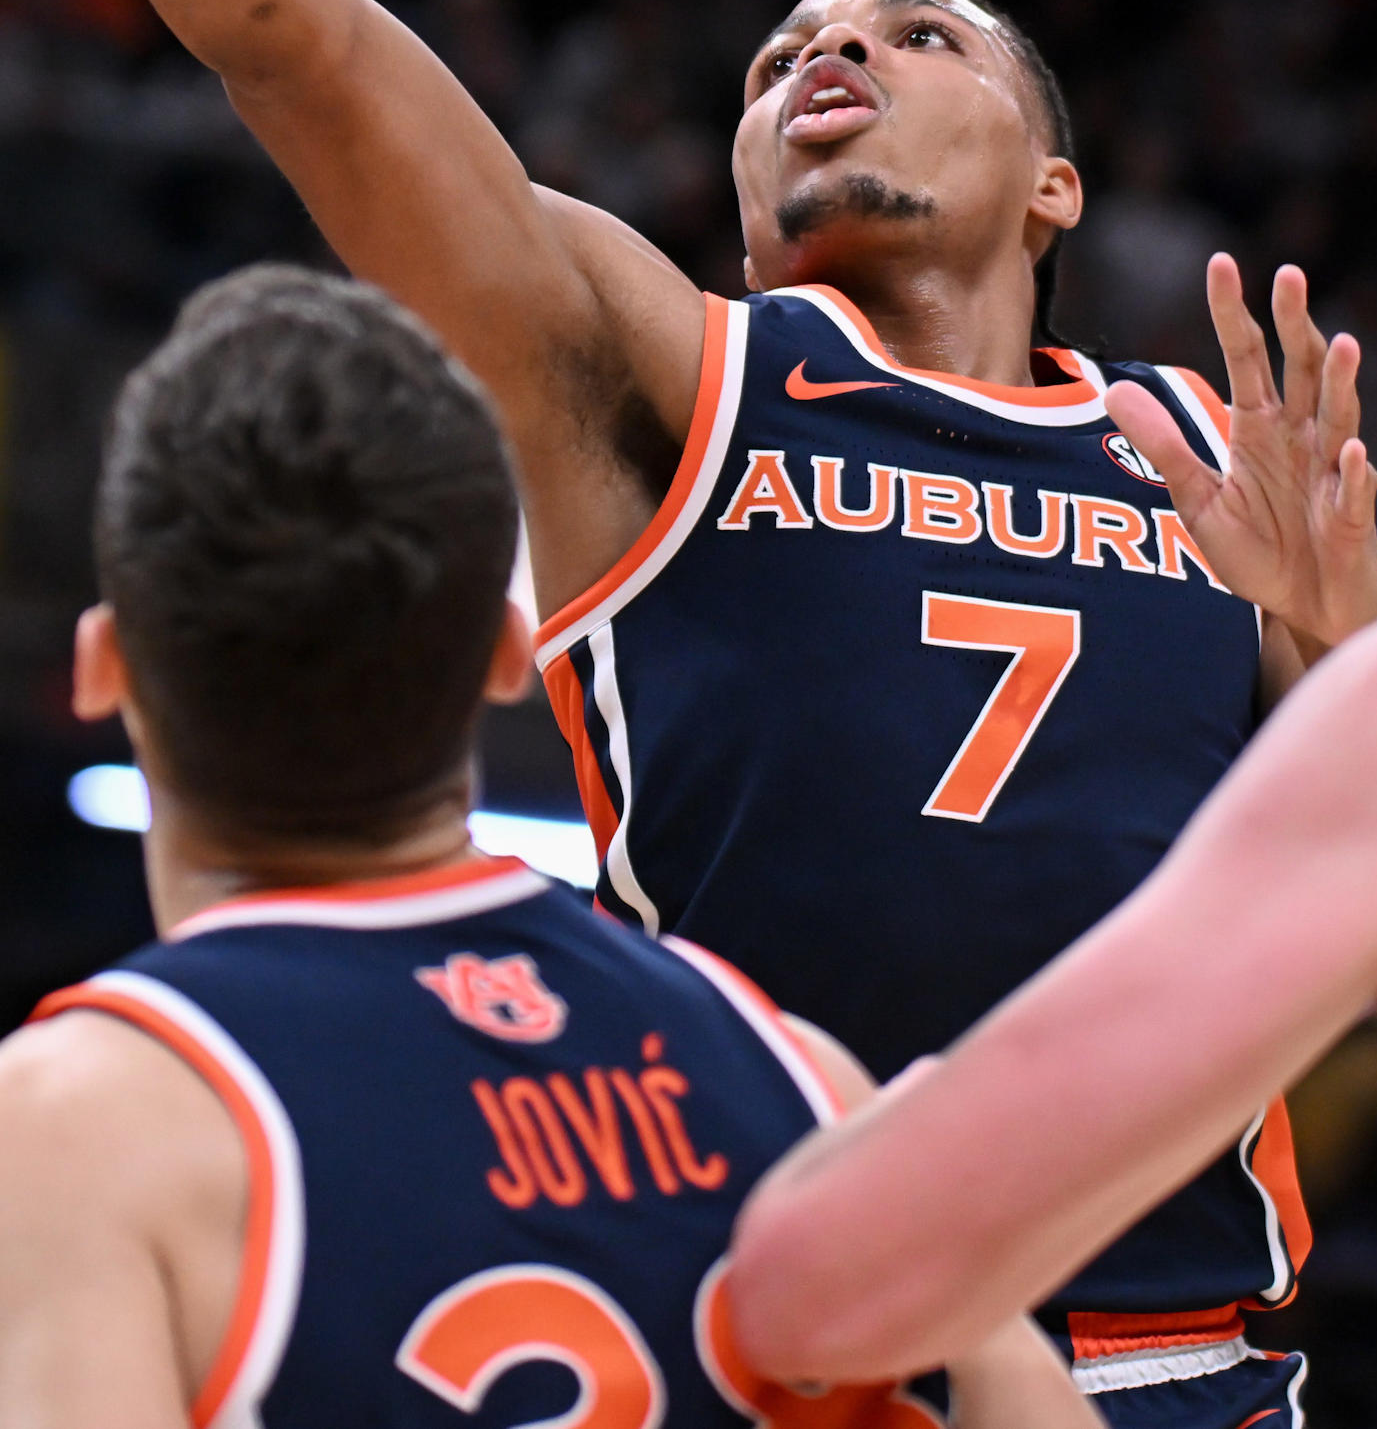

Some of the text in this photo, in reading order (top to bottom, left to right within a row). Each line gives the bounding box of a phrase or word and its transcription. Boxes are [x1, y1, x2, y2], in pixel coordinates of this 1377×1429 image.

[715, 449, 1233, 596] AUBURN
[920, 589, 1082, 824] 7
[469, 1030, 730, 1210] JOVIĆ
